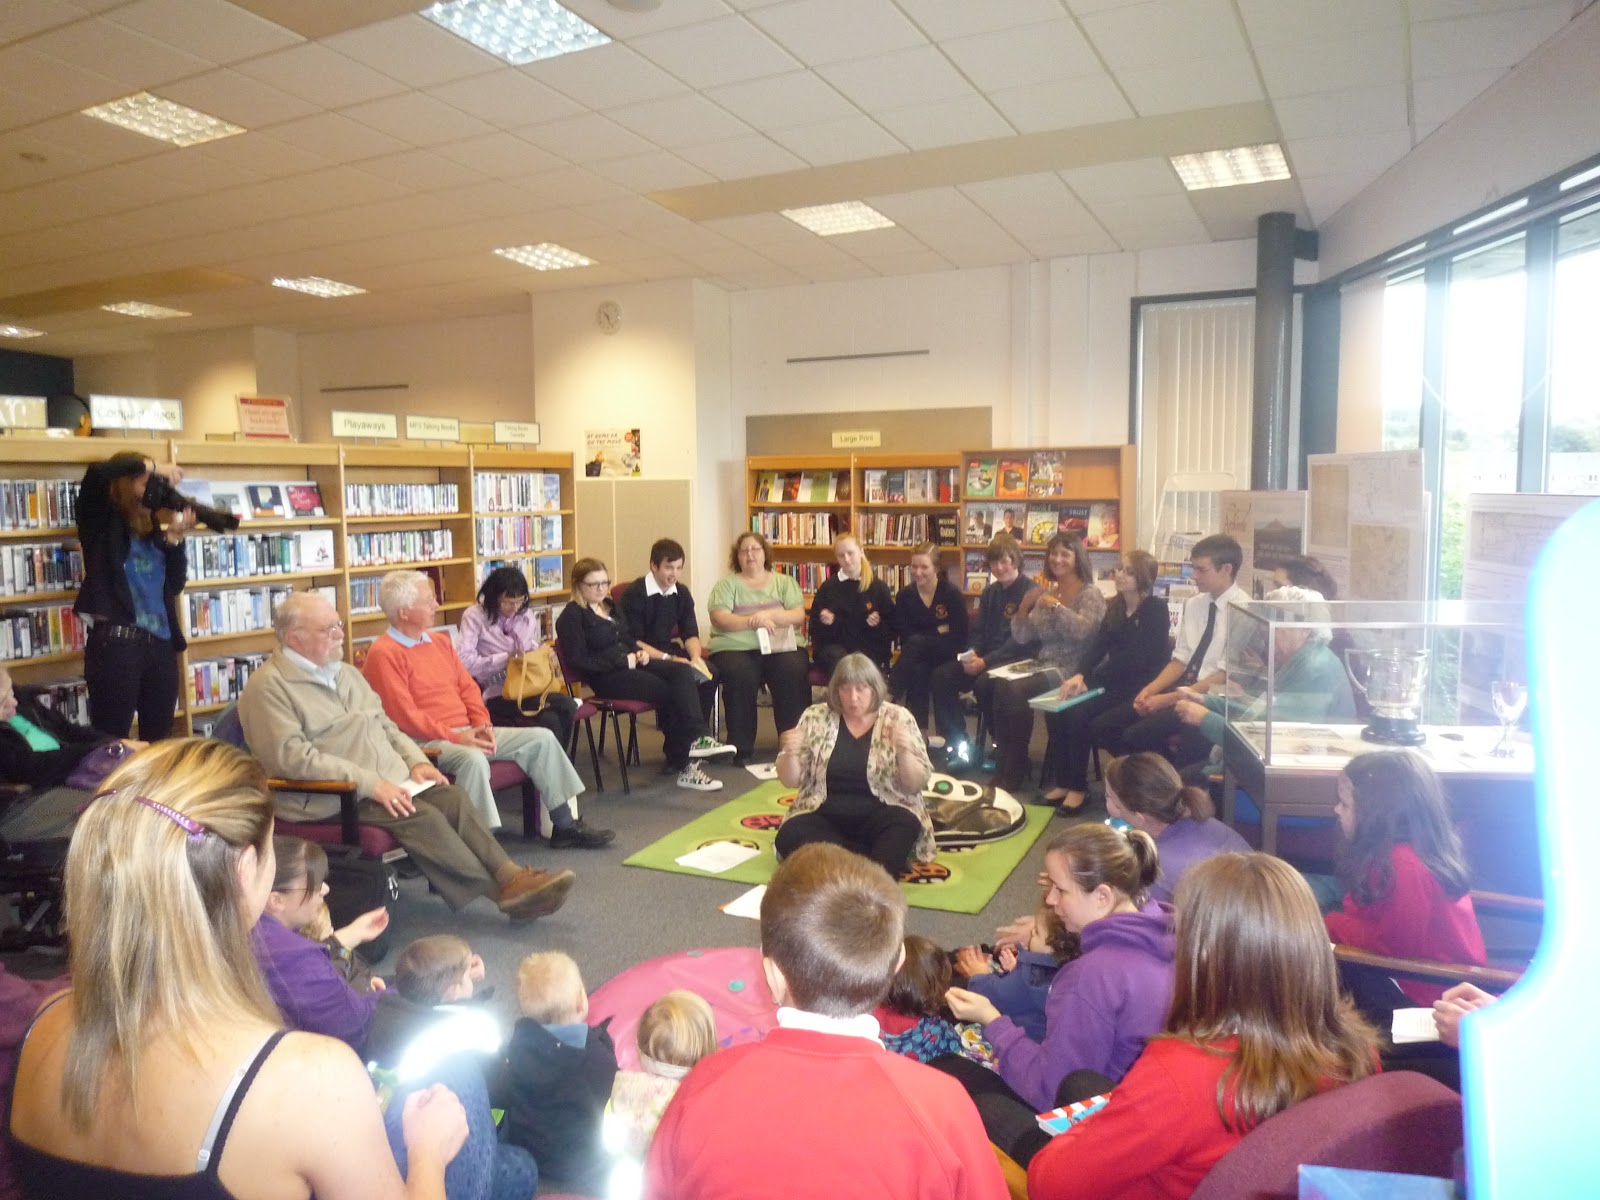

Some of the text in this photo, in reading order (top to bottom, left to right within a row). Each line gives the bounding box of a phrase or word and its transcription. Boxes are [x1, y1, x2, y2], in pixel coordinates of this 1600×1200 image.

[344, 418, 386, 431] Playaways
[423, 422, 440, 432] Talking
[441, 423, 456, 431] Books
[840, 434, 874, 443] Large Print
